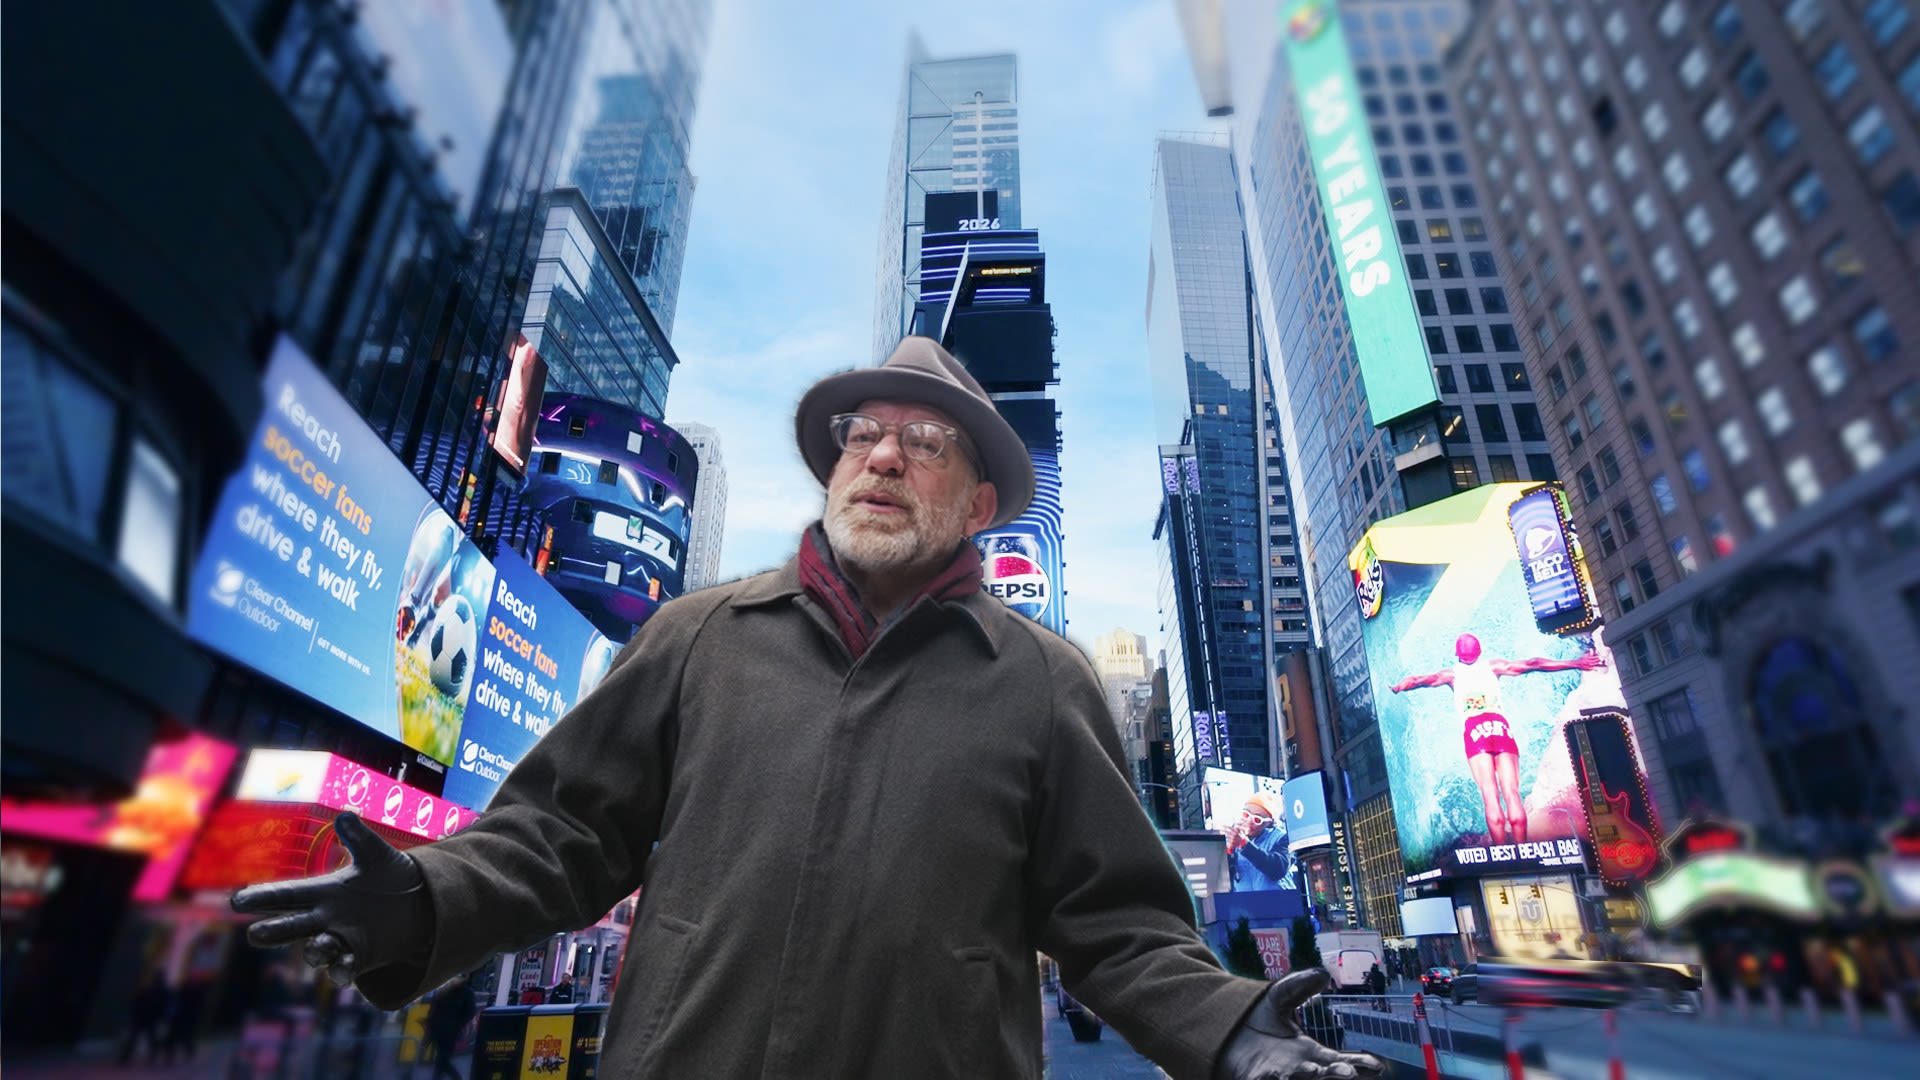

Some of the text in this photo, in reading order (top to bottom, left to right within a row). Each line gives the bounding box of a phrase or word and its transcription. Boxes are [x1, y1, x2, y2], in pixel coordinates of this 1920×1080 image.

[958, 218, 1000, 231] 2026
[1322, 135, 1391, 297] YEARS
[278, 382, 341, 464] Reach
[264, 427, 372, 535] soccer fans
[253, 464, 383, 590] where they fly,
[237, 504, 357, 611] drive & walk
[1528, 553, 1563, 571] TACO
[1534, 565, 1568, 583] BELL
[238, 597, 281, 632] Outdoor
[245, 579, 314, 632] Clear Channel
[496, 579, 537, 630] Reach
[489, 616, 559, 680] soccer fans
[475, 679, 509, 717] drive
[512, 701, 522, 726] &
[484, 648, 524, 690] where
[525, 671, 552, 712] they
[479, 746, 496, 764] Clear
[1195, 711, 1212, 758] ROKU
[475, 761, 501, 782] Outdoor
[1333, 822, 1358, 925] TIMES SQUARE
[1455, 847, 1488, 865] VOTED
[1490, 844, 1517, 861] BEST
[1518, 840, 1556, 859] BEACH
[1261, 951, 1281, 967] OT
